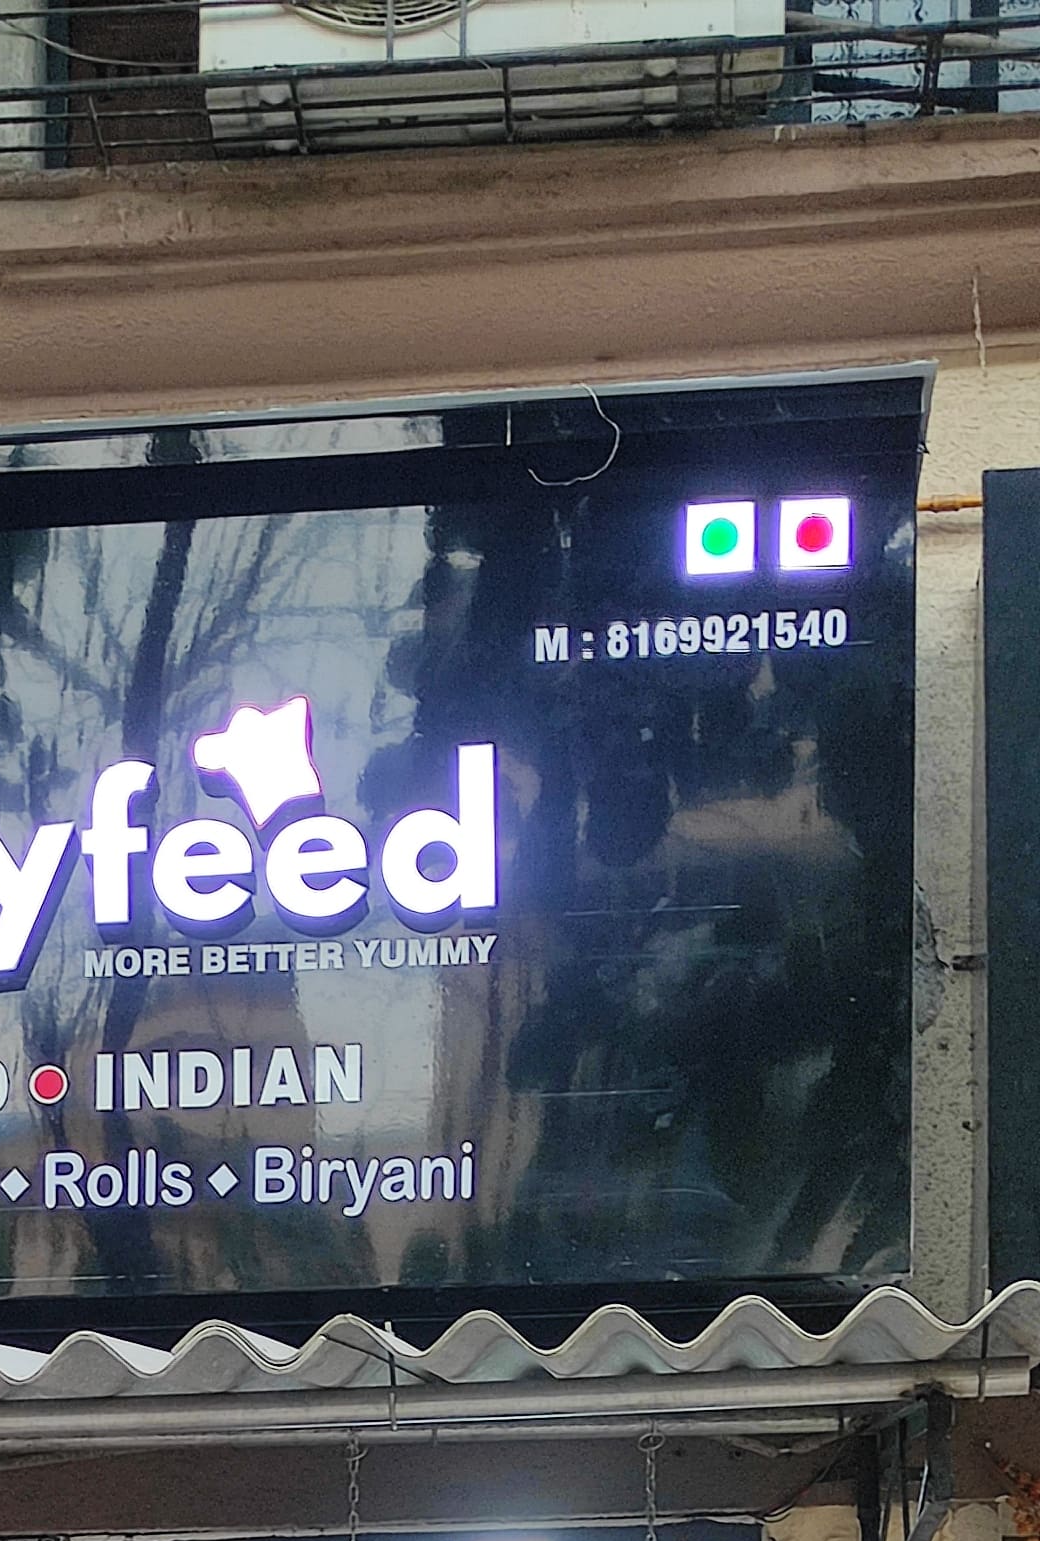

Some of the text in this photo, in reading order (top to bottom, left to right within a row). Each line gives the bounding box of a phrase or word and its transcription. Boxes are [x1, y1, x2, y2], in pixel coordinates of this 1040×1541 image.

[535, 627, 569, 662] M
[606, 608, 848, 658] 8169921540
[83, 935, 498, 978] MORE BETTER YUMMY
[94, 1044, 362, 1111] INDIAN
[44, 1149, 193, 1209] Rolls
[253, 1141, 474, 1217] Biryani
